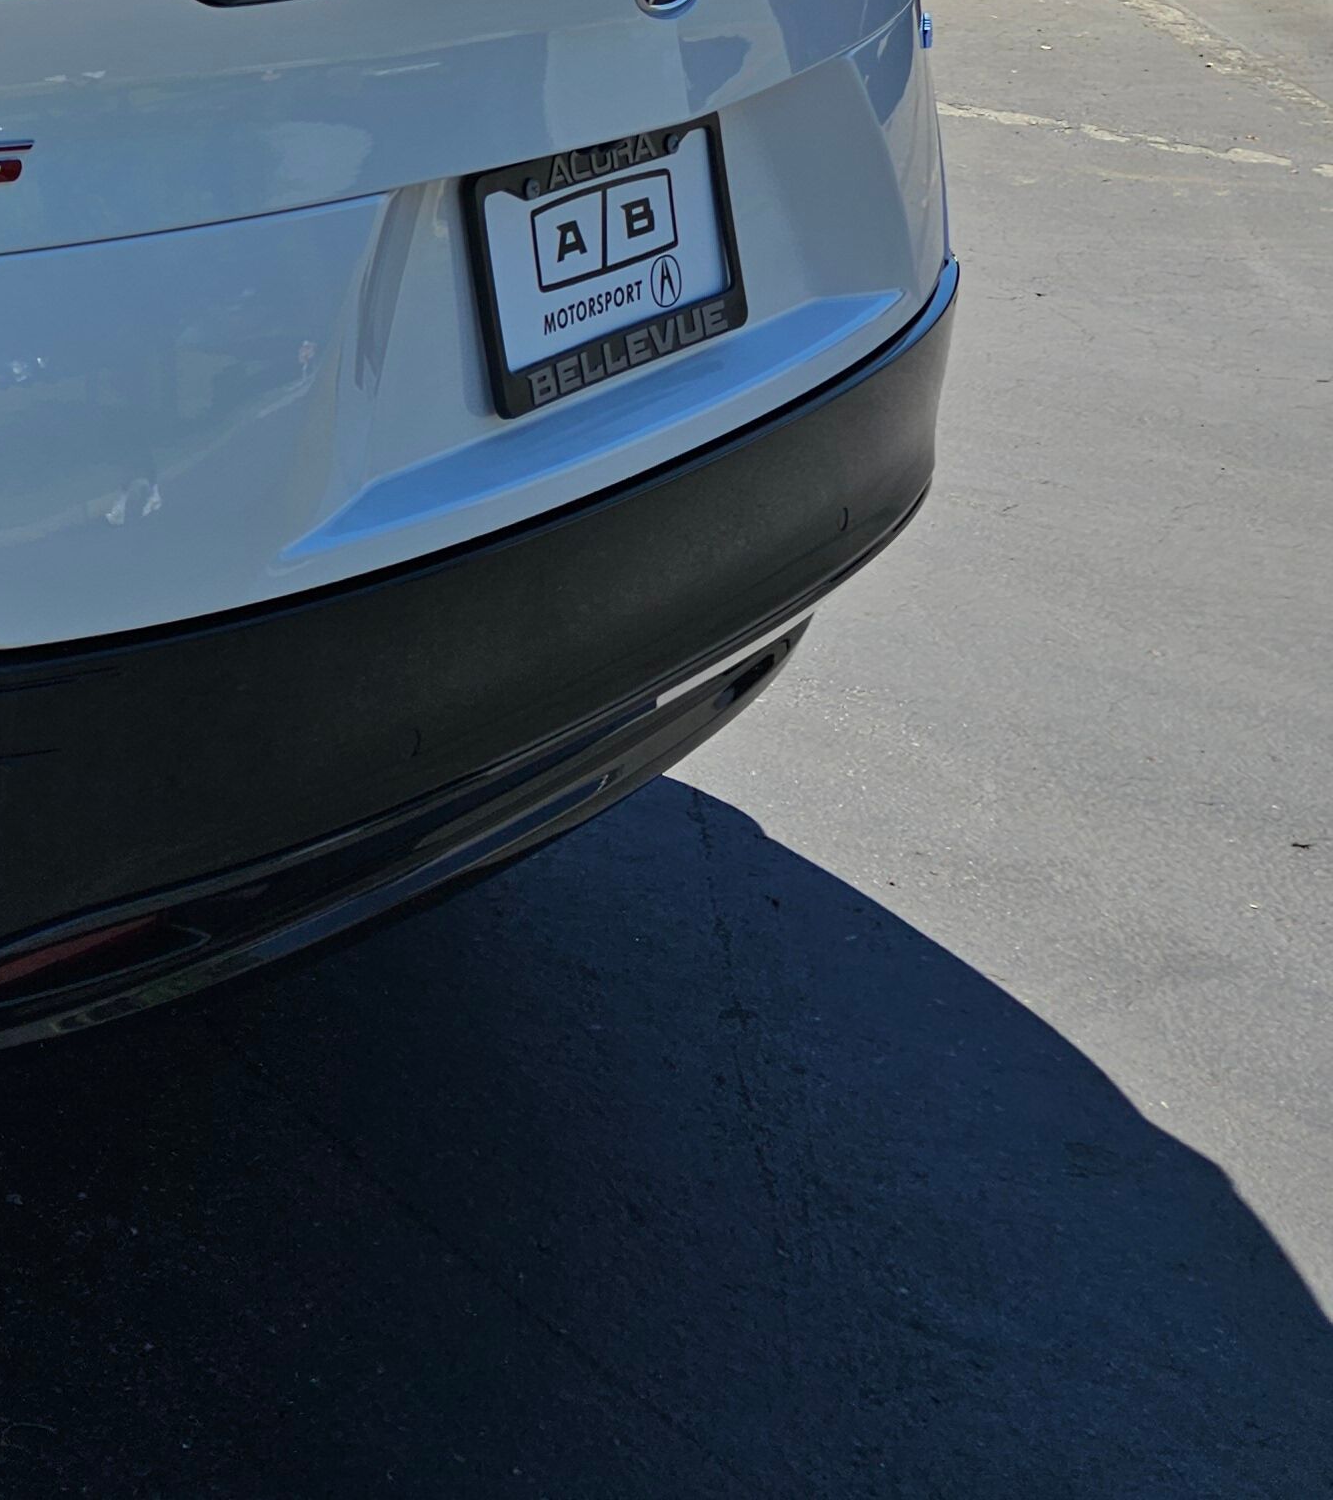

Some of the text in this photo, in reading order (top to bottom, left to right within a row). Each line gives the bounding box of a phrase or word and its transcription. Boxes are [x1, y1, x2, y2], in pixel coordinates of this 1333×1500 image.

[549, 133, 657, 190] ACURA
[556, 197, 655, 263] A B
[544, 280, 643, 336] MOTORSPORT
[526, 301, 729, 405] BELLEVUE
